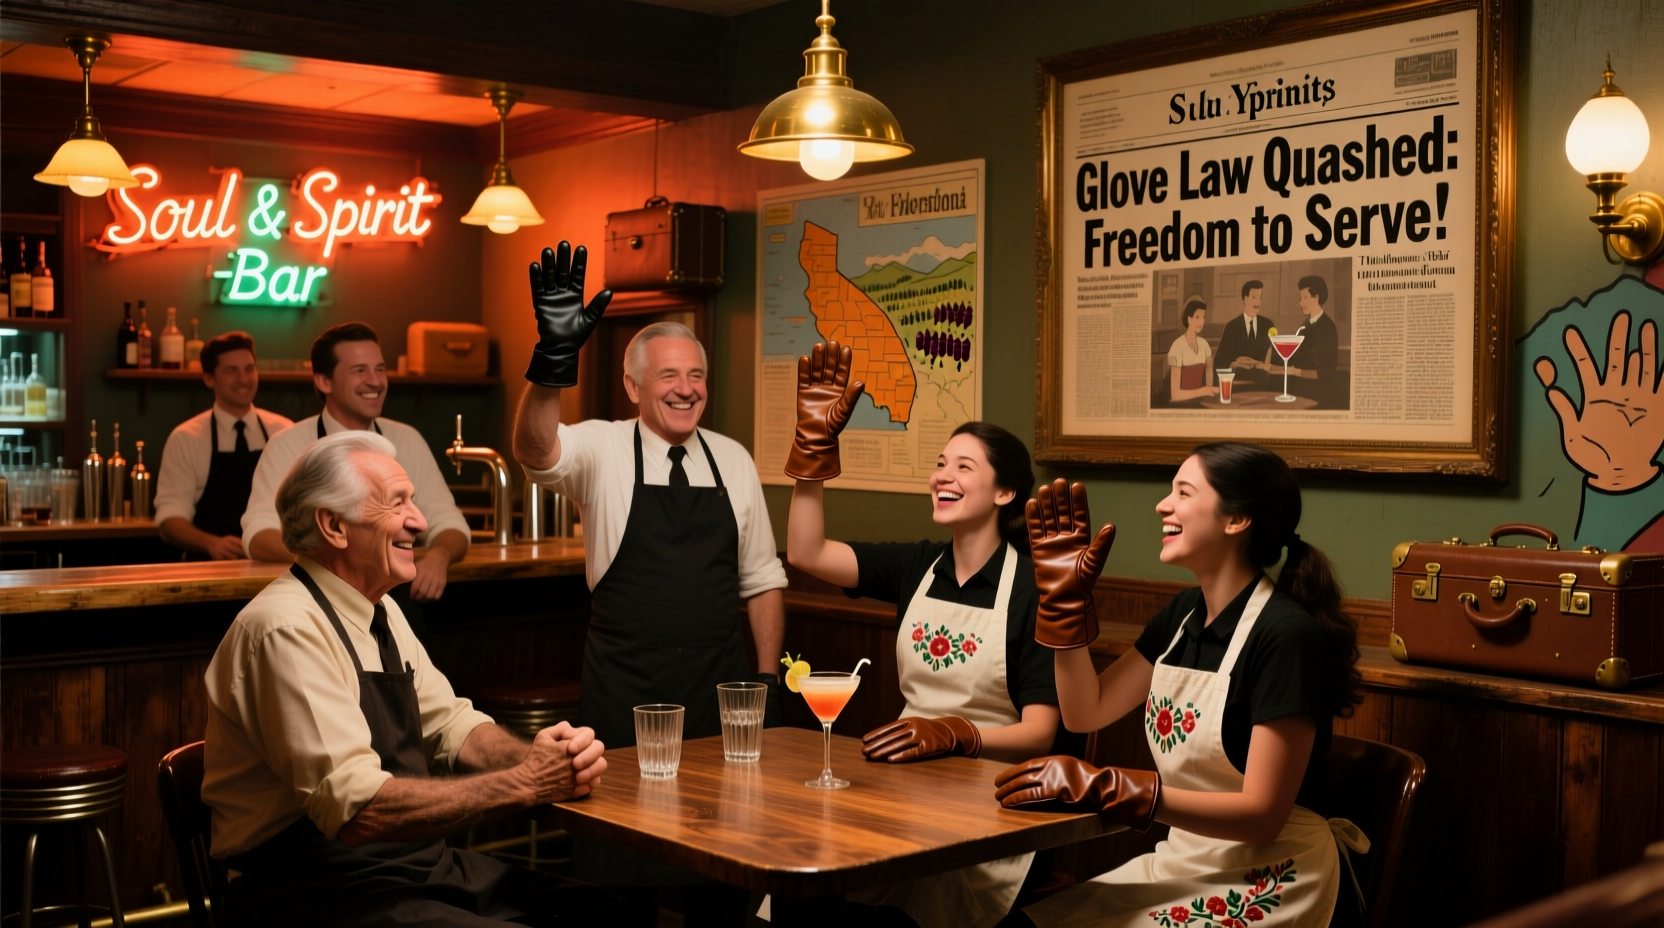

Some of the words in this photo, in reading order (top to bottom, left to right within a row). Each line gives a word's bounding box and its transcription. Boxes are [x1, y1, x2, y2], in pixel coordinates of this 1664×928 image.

[1076, 160, 1169, 213] Glove
[1179, 149, 1254, 201] Law
[1263, 114, 1459, 198] Quashed:
[107, 166, 240, 245] Soul
[248, 183, 286, 240] &
[293, 170, 436, 258] Spirit
[1084, 209, 1241, 269] Freedom
[1251, 205, 1293, 255] to
[1304, 181, 1450, 251] Serve!
